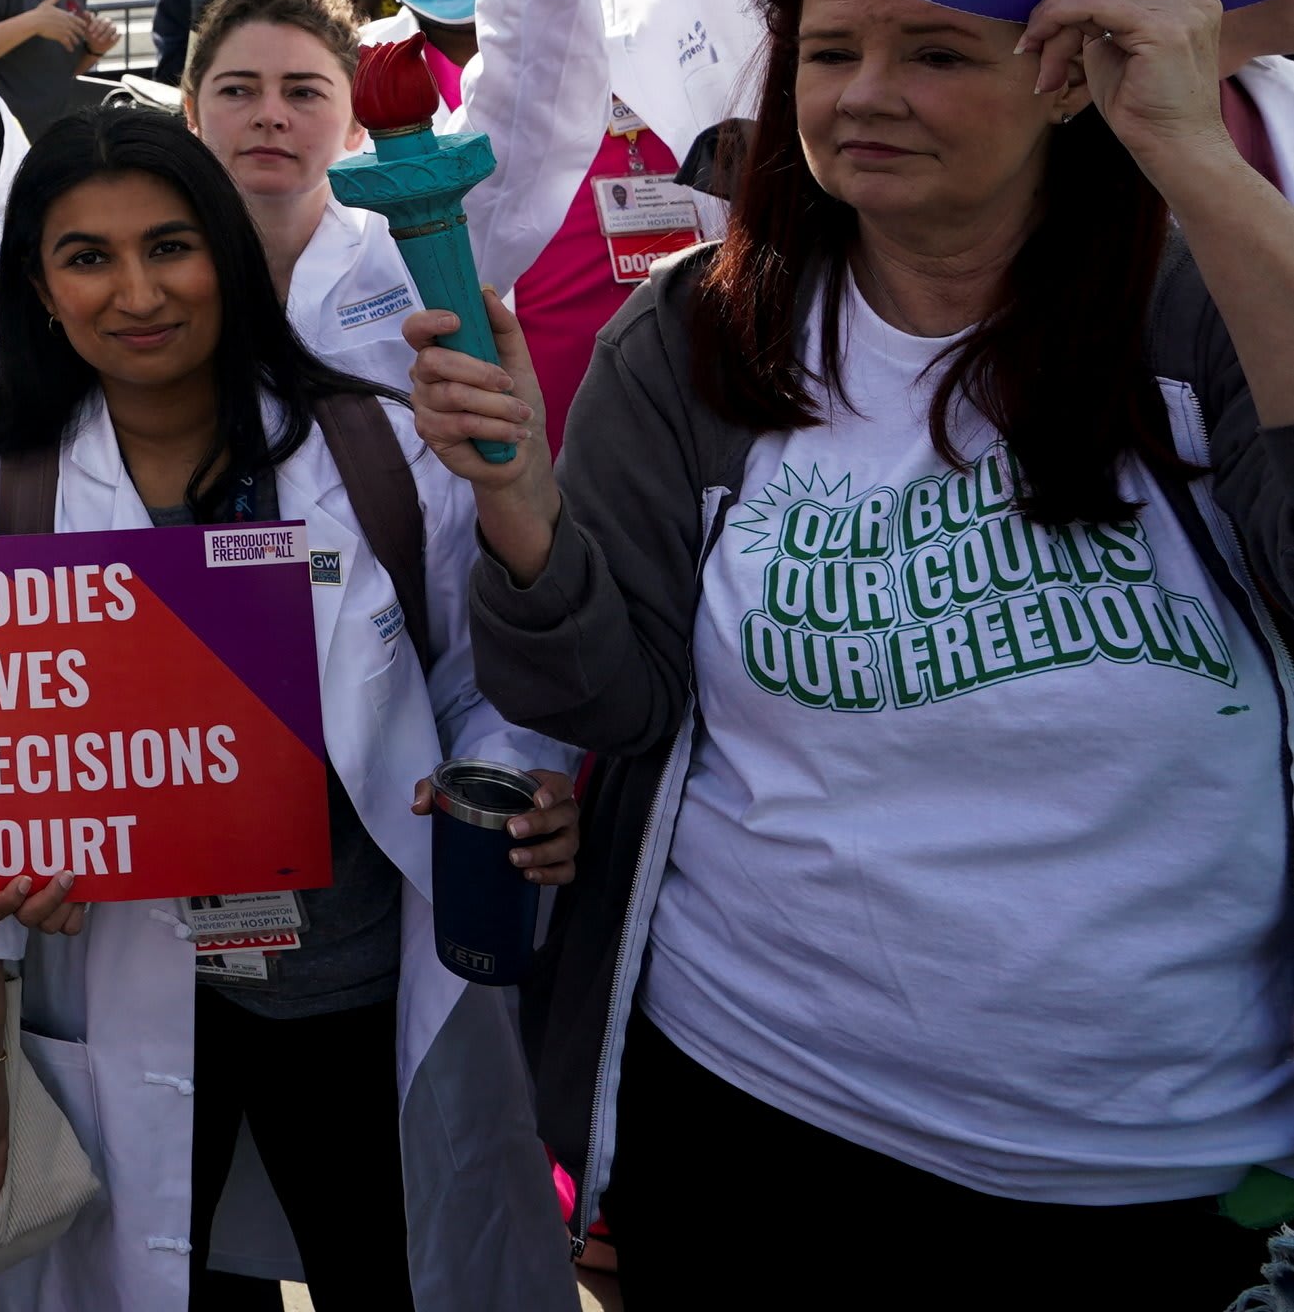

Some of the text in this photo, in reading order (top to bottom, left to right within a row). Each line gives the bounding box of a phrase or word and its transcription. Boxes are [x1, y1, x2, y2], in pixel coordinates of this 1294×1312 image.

[647, 218, 692, 227] HOSPITAL
[618, 251, 675, 274] DOC
[369, 297, 412, 319] HOSPITAL
[784, 448, 1025, 562] OUR BOD
[212, 531, 294, 549] REPRODUCTIVE
[213, 547, 265, 562] FREEDOM
[275, 545, 295, 559] ALL
[311, 554, 339, 569] GW
[767, 557, 895, 632] OUR
[374, 613, 390, 628] THE
[744, 585, 1231, 709] OUR FREEDOM
[193, 907, 293, 922] THE GEORGE WASHINGTON
[194, 916, 296, 931] UNIVERSITY HOSPITAL
[444, 941, 490, 970] YETI
